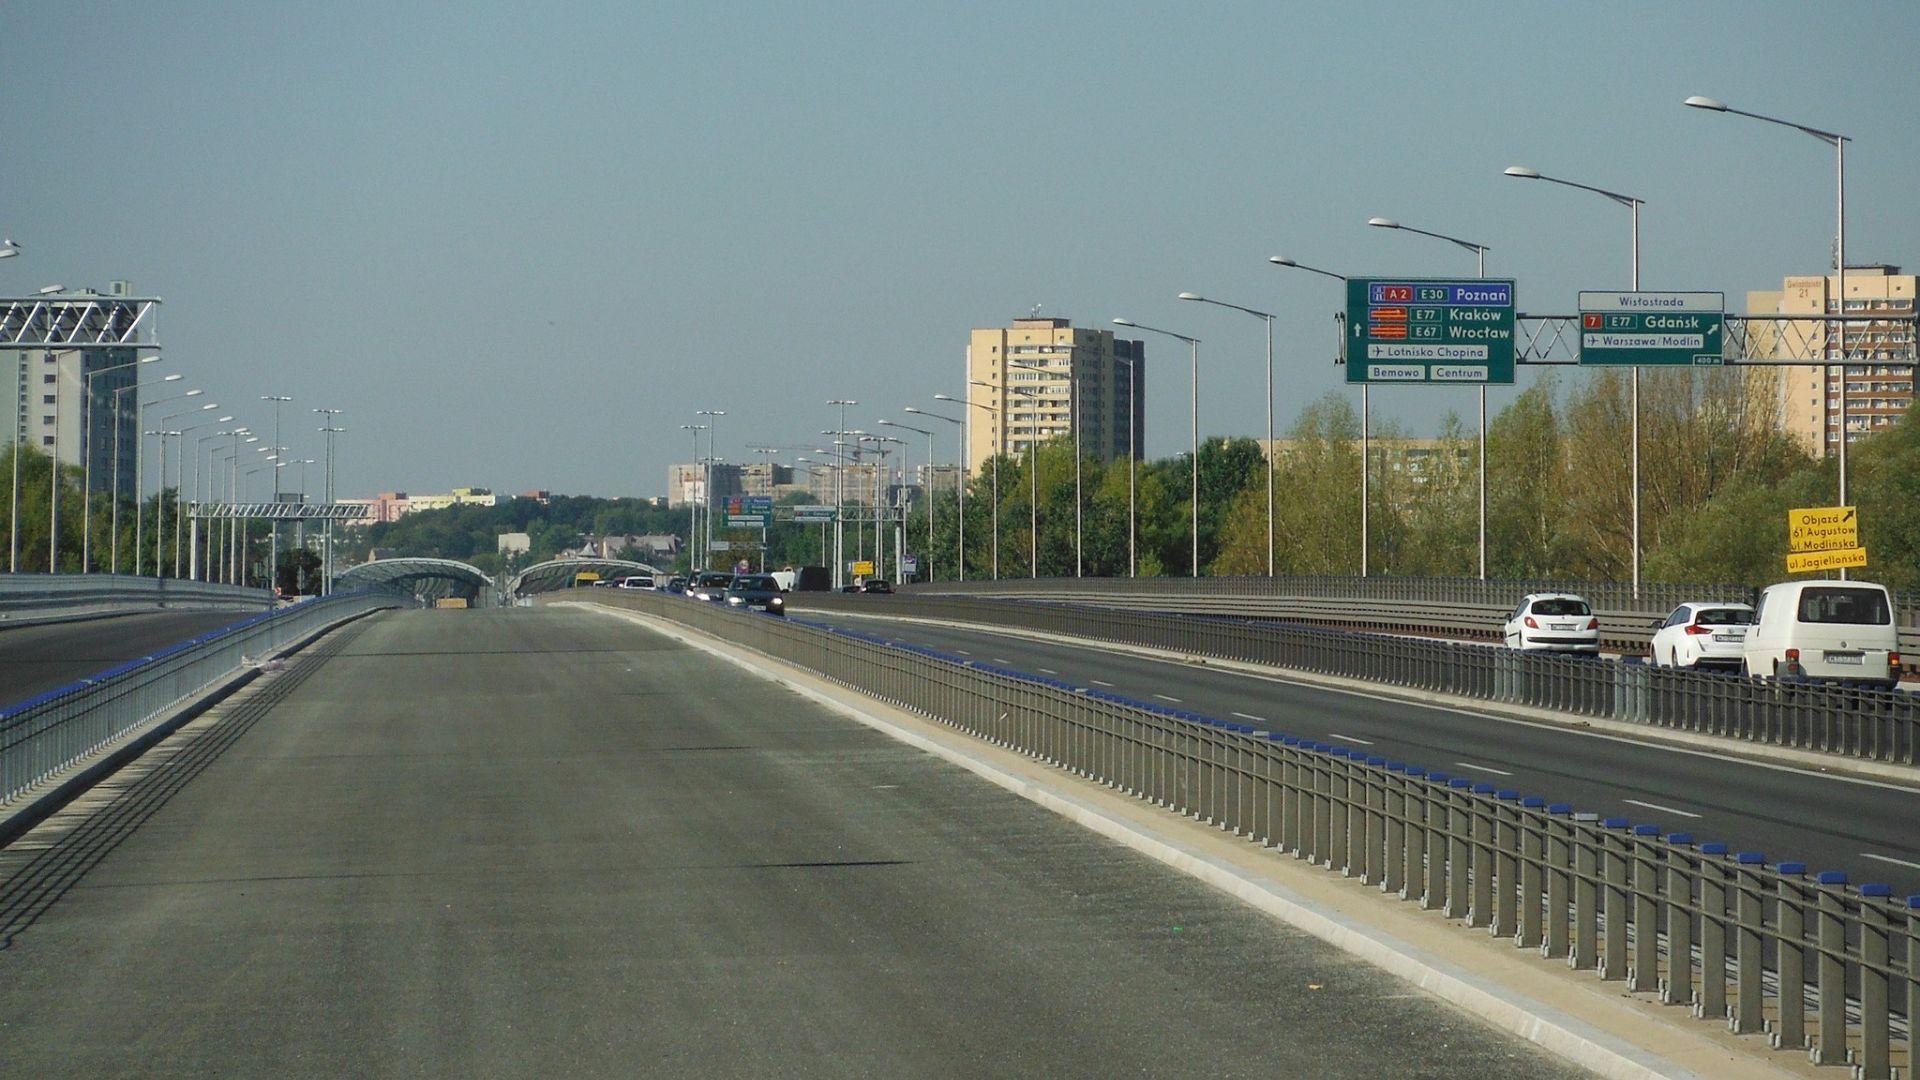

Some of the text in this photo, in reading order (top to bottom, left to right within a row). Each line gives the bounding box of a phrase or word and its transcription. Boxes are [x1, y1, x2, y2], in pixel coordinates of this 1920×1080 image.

[1456, 286, 1507, 301] Poznań
[1619, 296, 1684, 307] Wisłostrada
[1449, 307, 1501, 321] Kraków
[1590, 317, 1596, 326] 7
[1645, 315, 1699, 329] Gdańsk
[1449, 326, 1509, 339] Wrocław
[1388, 347, 1483, 358] Lotnisko Chopina
[1374, 368, 1419, 378] Bemowo
[1436, 368, 1482, 378] Centrum
[1802, 514, 1839, 526] Objazd
